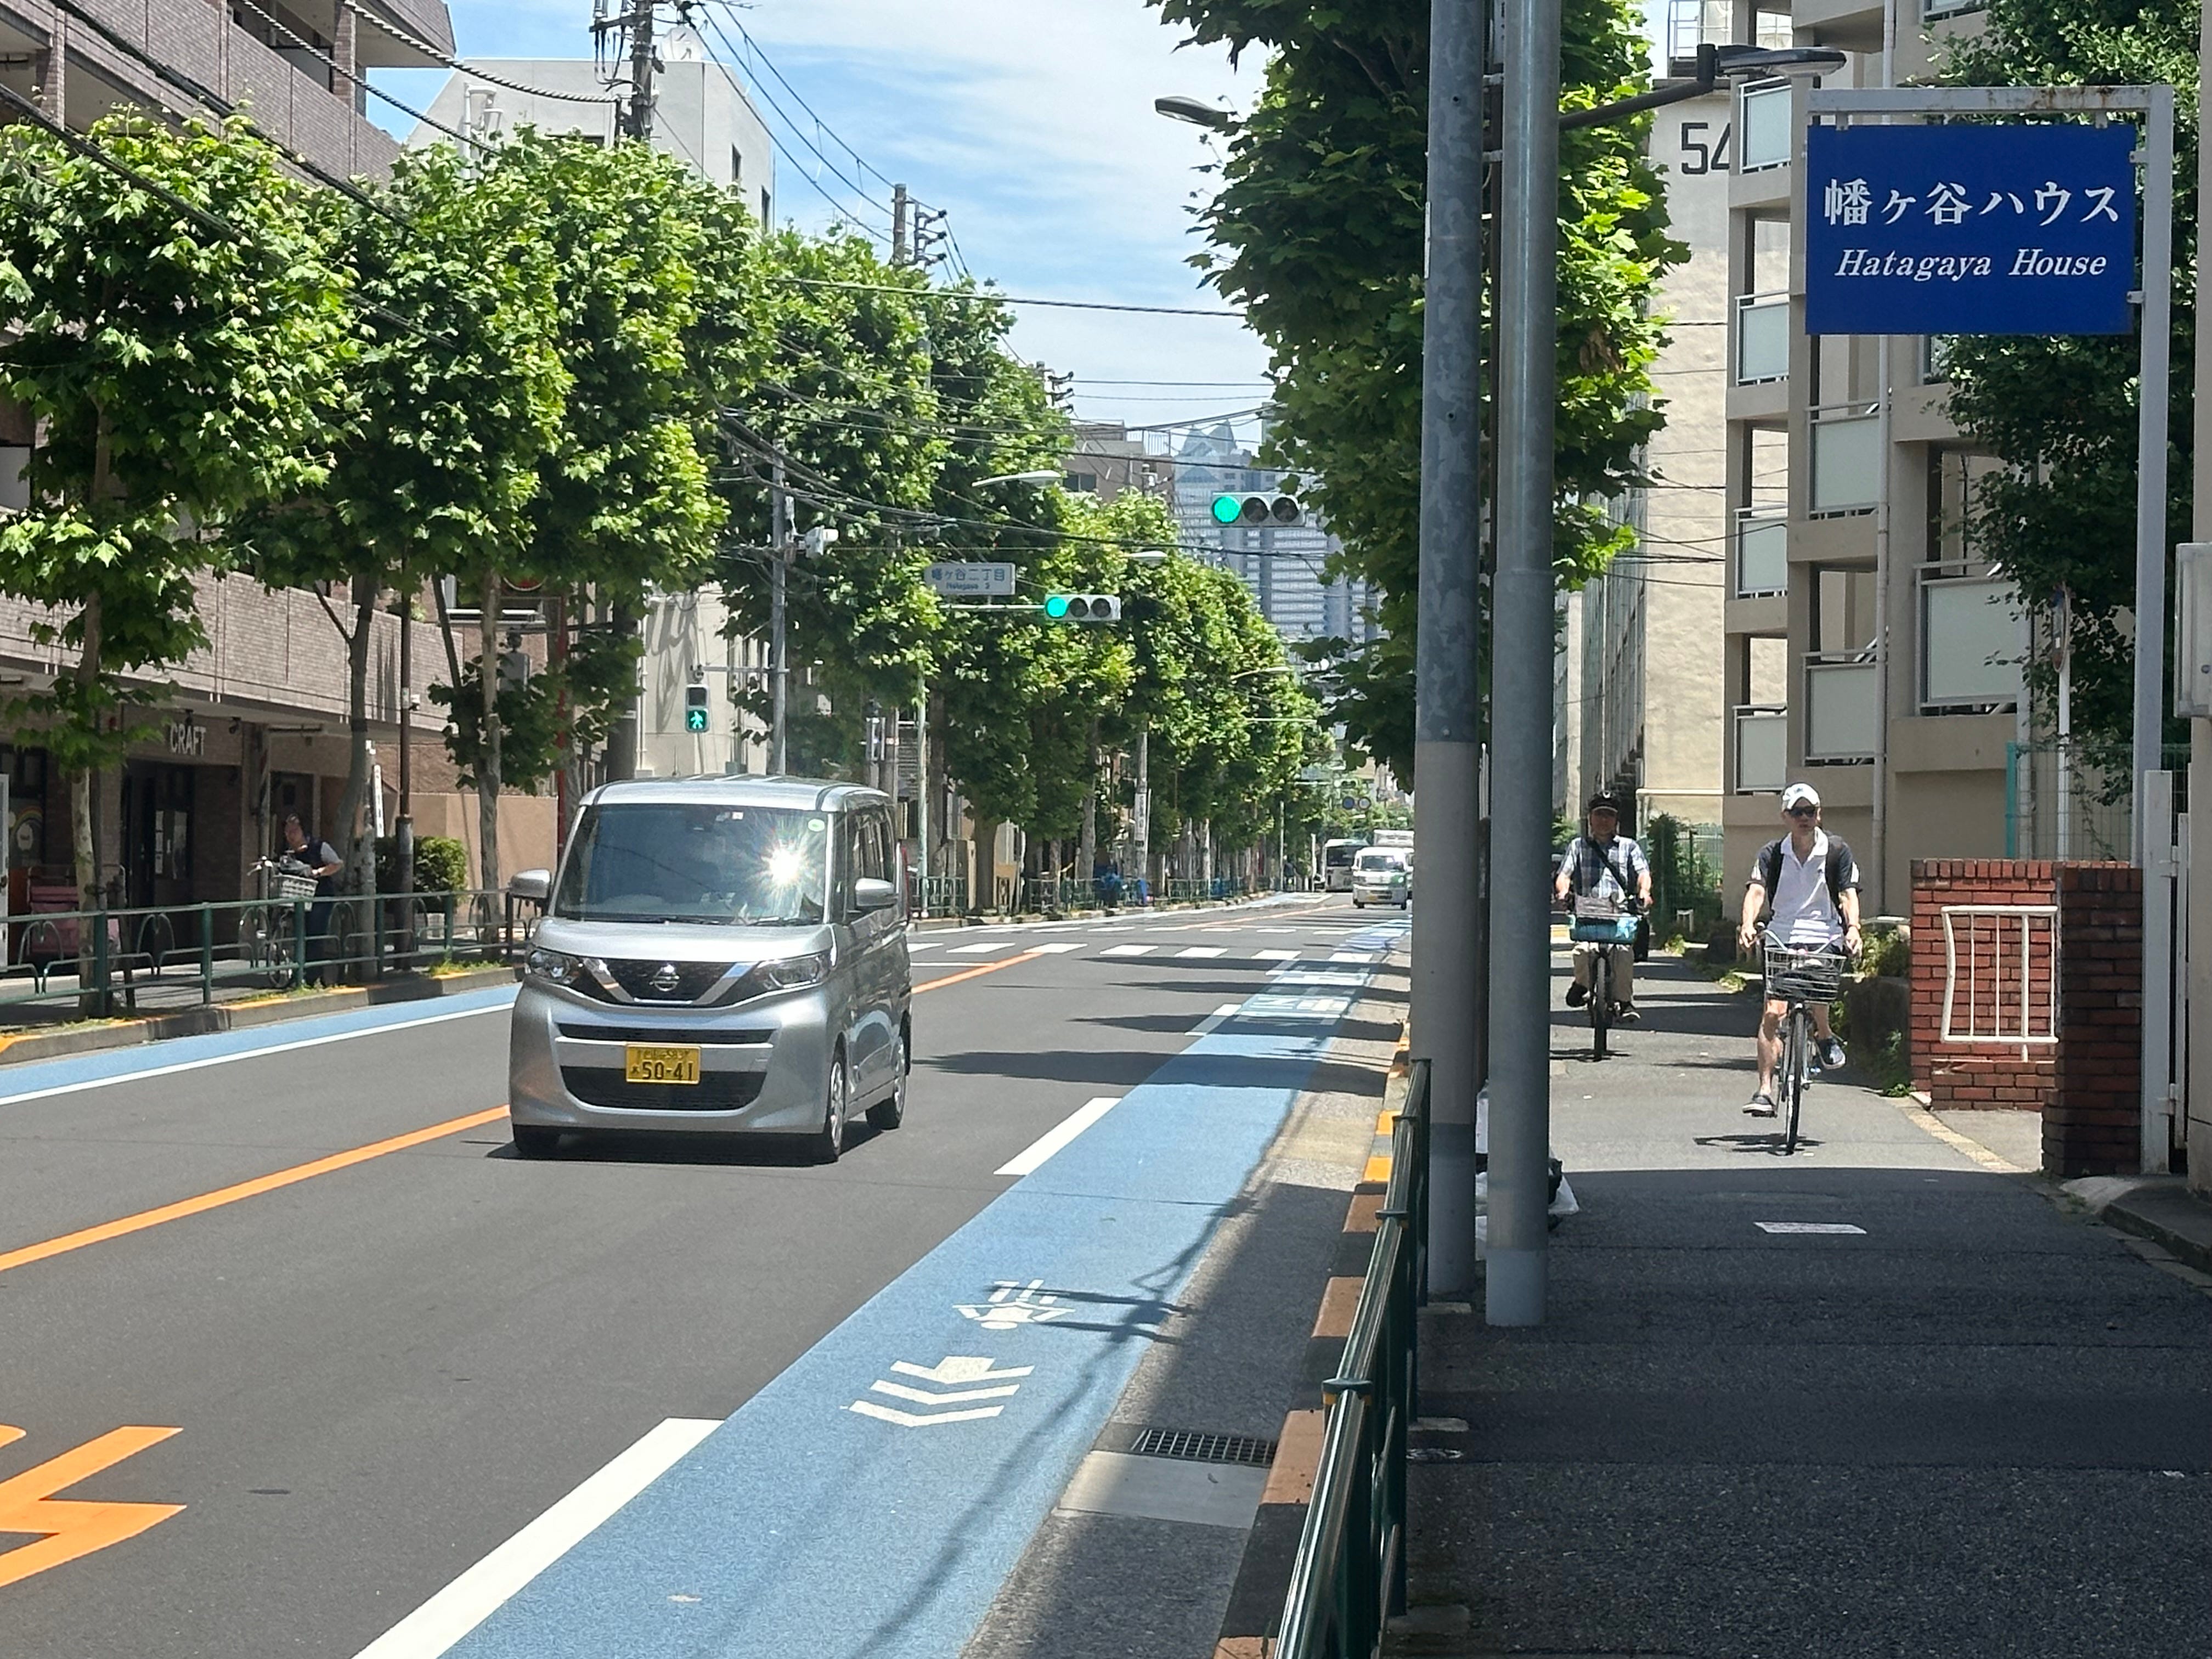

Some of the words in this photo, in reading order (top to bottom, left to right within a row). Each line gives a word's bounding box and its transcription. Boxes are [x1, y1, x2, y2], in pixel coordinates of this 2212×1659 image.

[1834, 249, 1992, 282] Hatagaya
[2008, 248, 2107, 276] House
[170, 723, 206, 755] CRAFT
[642, 1061, 693, 1080] 50-41
